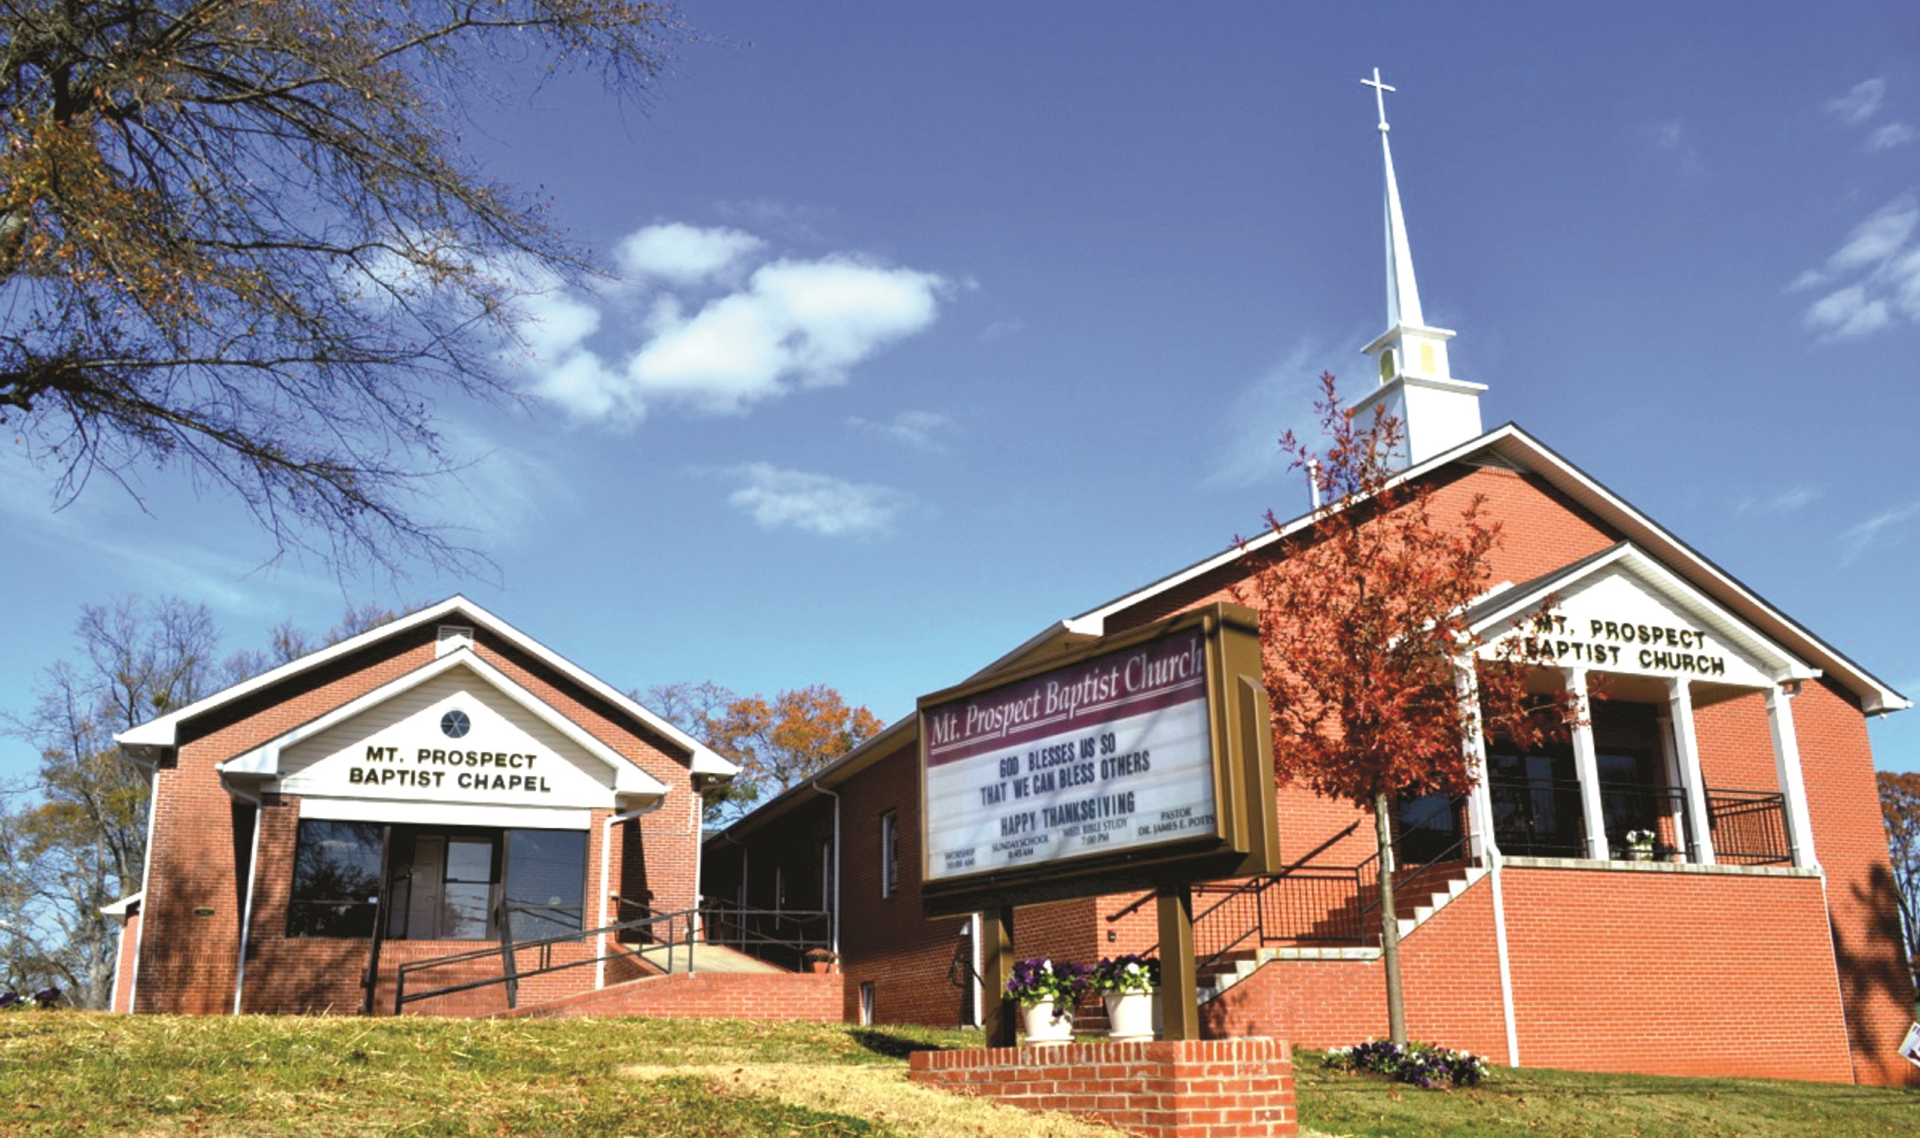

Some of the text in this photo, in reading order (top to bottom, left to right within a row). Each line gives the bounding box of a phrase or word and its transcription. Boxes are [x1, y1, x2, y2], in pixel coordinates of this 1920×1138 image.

[1590, 619, 1705, 649] PROSPECT
[1524, 636, 1725, 677] BAPTIST CHURCH
[931, 637, 1203, 746] Mt. Prospect Baptist Church
[366, 746, 537, 769] MT. PROSPECT
[999, 732, 1116, 778] GOD BLESSES US SO
[349, 767, 551, 793] BAPTIST CHAPEL
[980, 750, 1150, 806] THAT WE CAN BLESS OTHERS
[1001, 791, 1135, 837] HAPPY THANKSGIVING
[1103, 817, 1128, 831] STUDY
[1161, 807, 1192, 821] PASTOR
